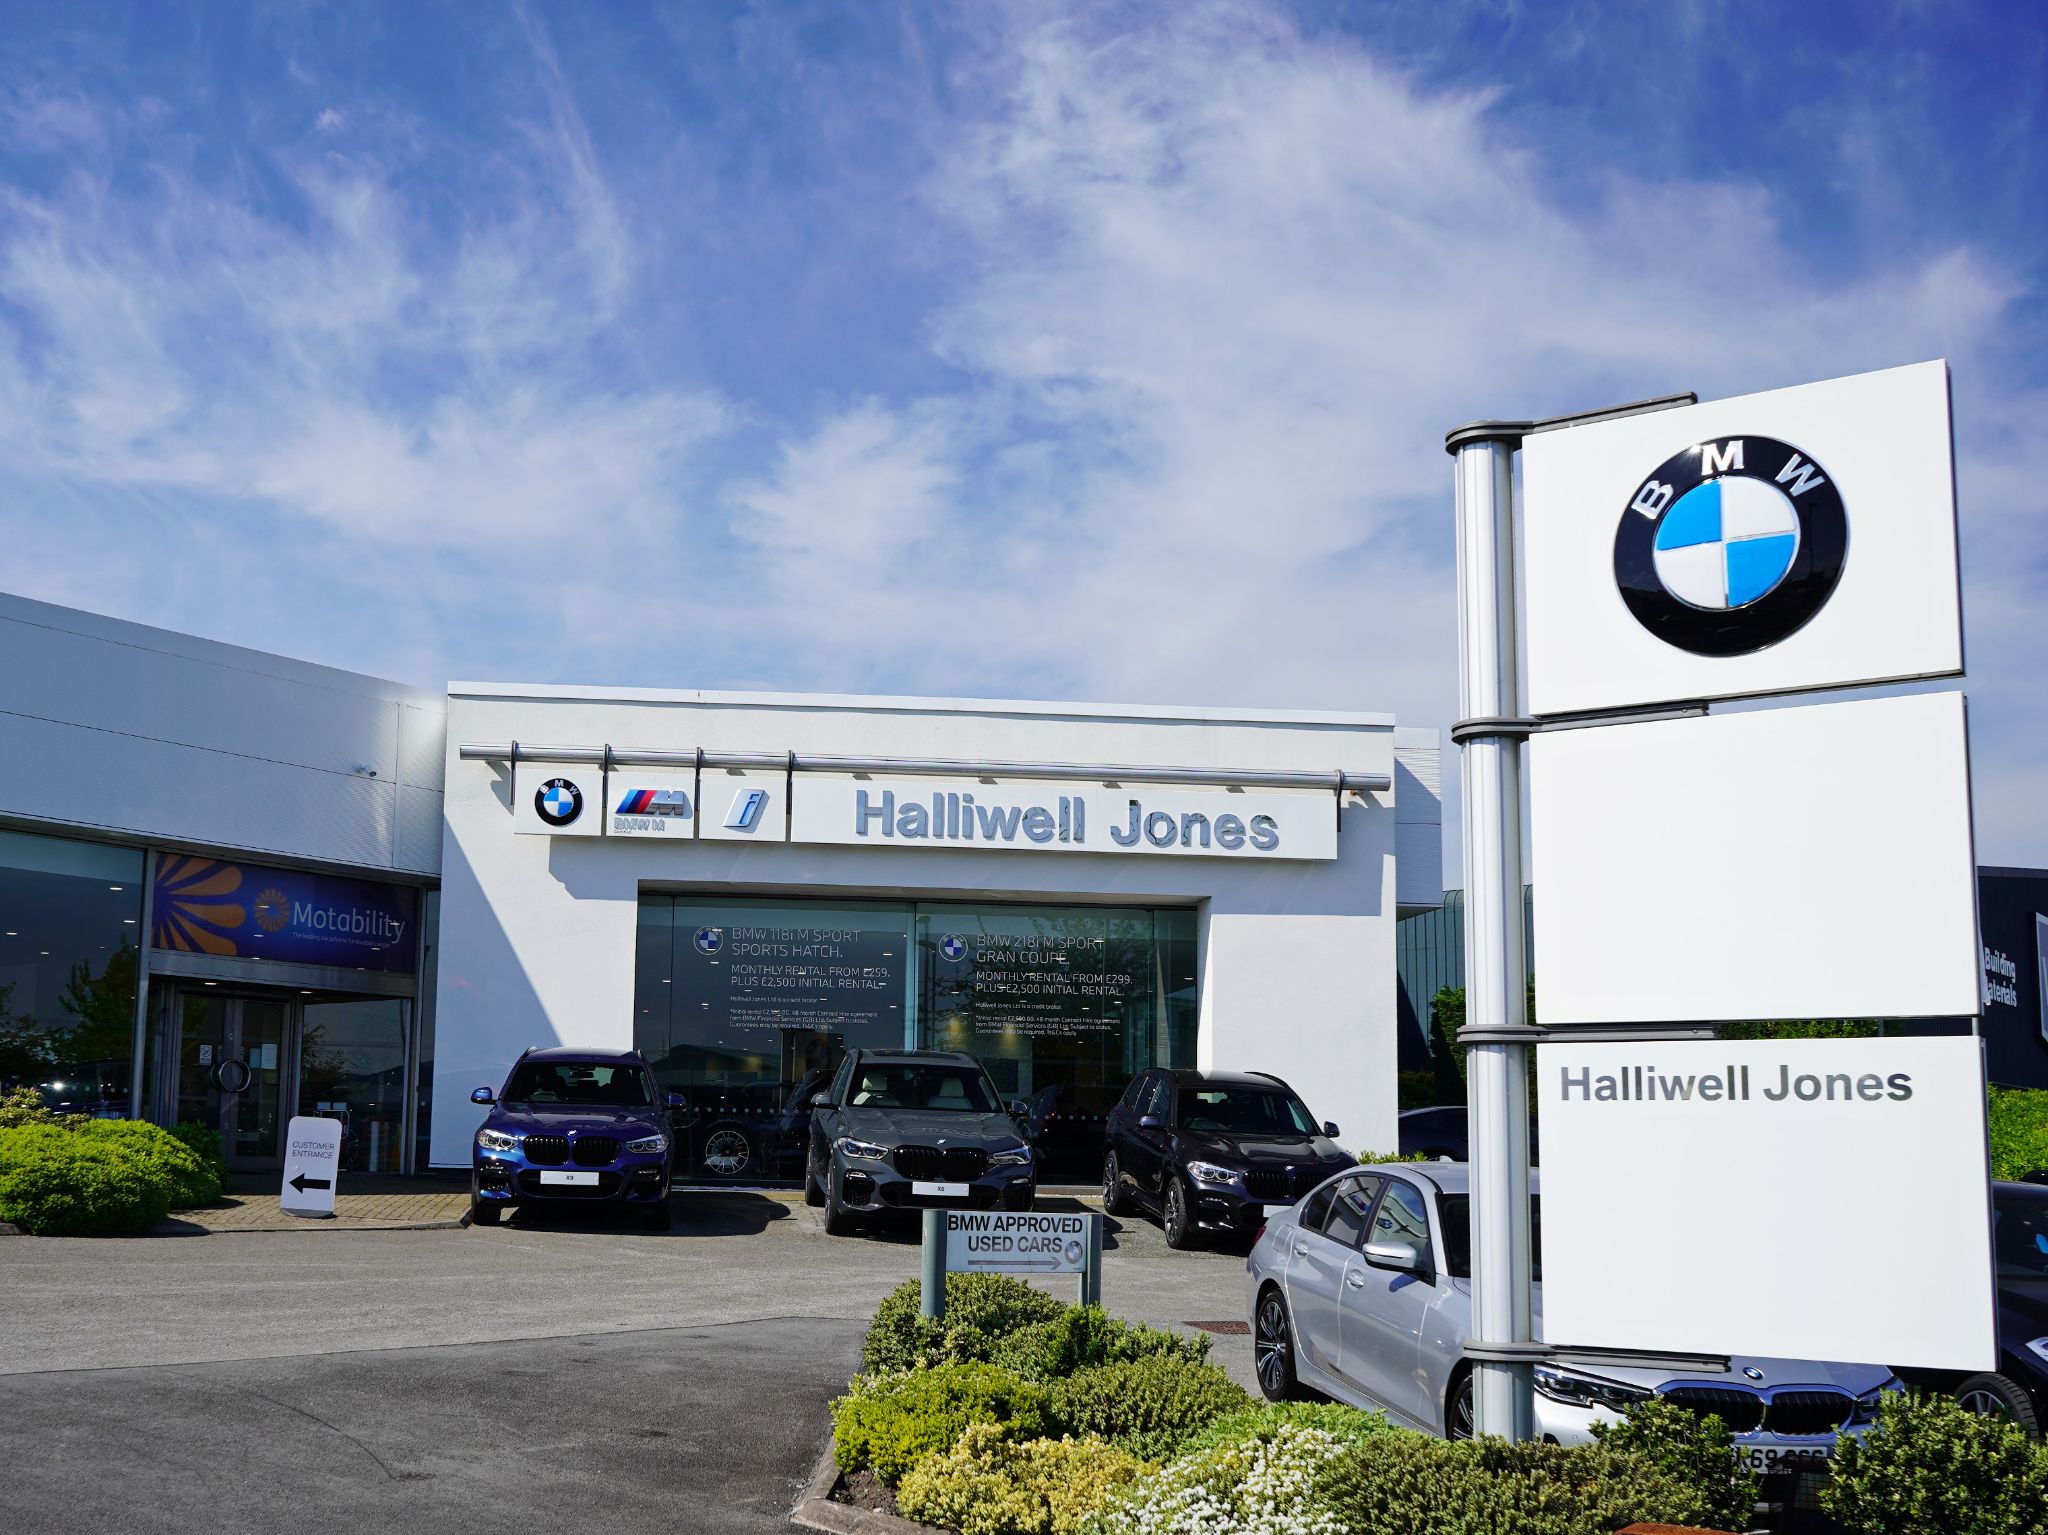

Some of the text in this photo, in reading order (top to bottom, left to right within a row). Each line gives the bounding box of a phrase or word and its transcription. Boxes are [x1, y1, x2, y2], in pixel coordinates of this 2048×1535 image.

[1632, 440, 1826, 520] BMW
[856, 790, 1280, 851] Halliwell Jones
[293, 902, 406, 944] Motability
[732, 927, 862, 943] BMW 118i M SPORT
[977, 935, 1105, 950] BMW 218i M SPORT
[732, 944, 843, 958] SPORTS HATCH.
[977, 950, 1016, 963] GRAN
[731, 965, 783, 976] MONTHLY
[786, 966, 827, 976] RENTAL
[829, 967, 860, 977] FROM
[1985, 947, 2016, 984] Building
[731, 977, 759, 987] PLUS
[762, 978, 796, 989] £2,500
[798, 978, 835, 988] INITIAL
[977, 972, 1134, 985] MONTHLY RENTAL FROM £299.
[976, 984, 1125, 996] PLUS £2,500 INITIAL RENTAL.
[1987, 978, 2017, 1008] aterials
[1560, 1064, 1913, 1102] Halliwell Jones
[292, 1141, 335, 1150] CUSTOMER
[292, 1150, 334, 1159] ENTRANCE
[948, 1215, 1083, 1234] BMW APPROVED
[968, 1236, 1014, 1253] USED
[1018, 1237, 1063, 1254] CARS
